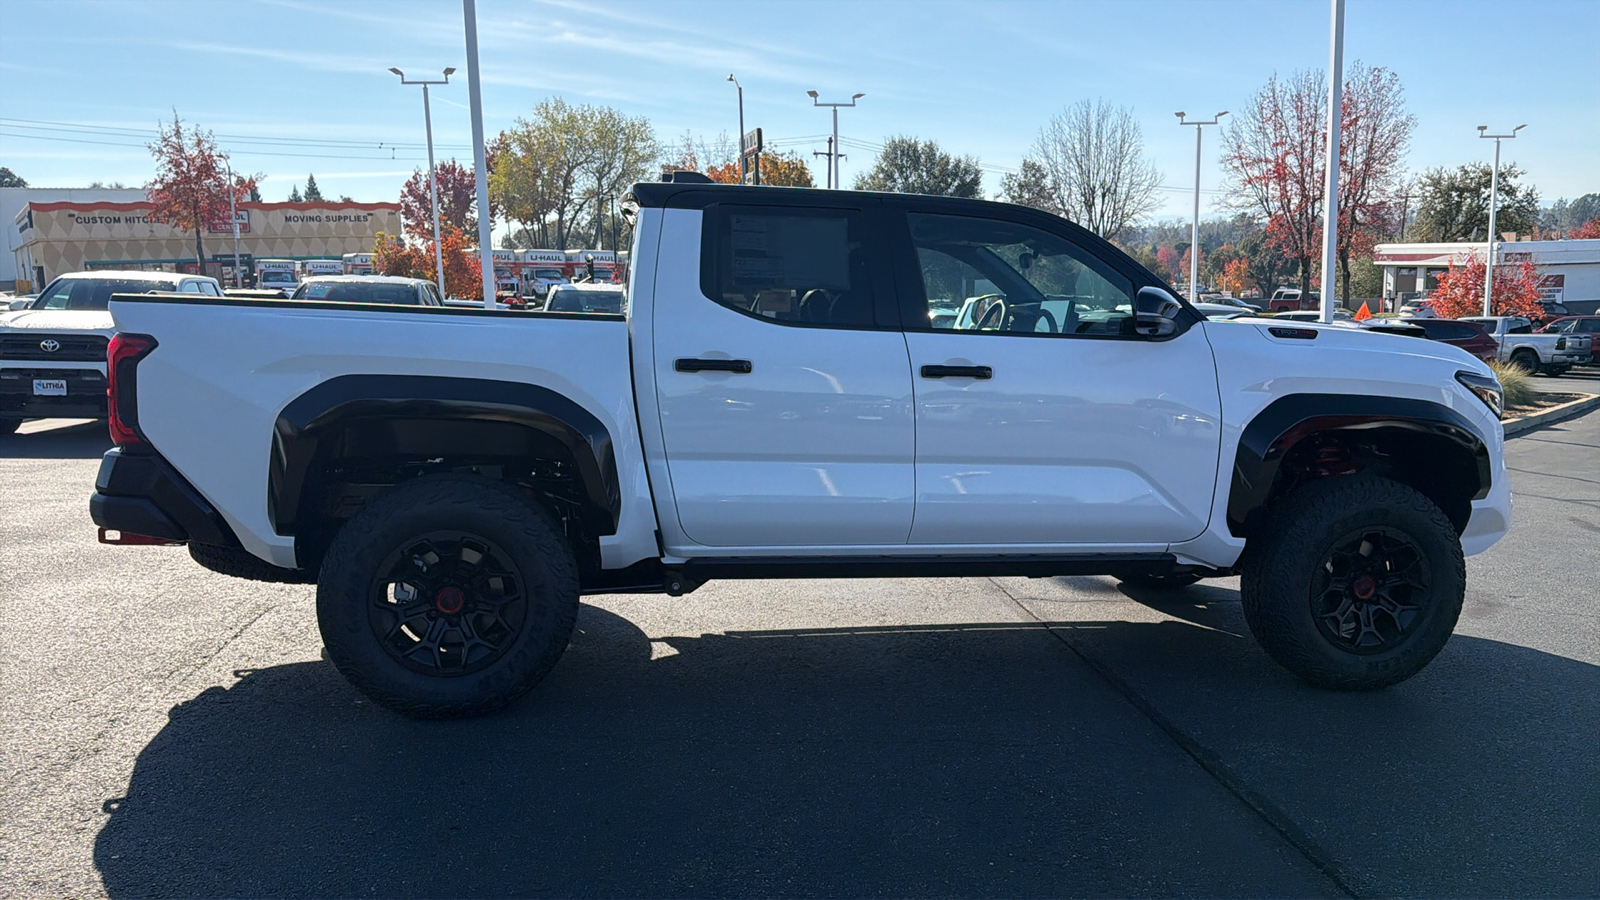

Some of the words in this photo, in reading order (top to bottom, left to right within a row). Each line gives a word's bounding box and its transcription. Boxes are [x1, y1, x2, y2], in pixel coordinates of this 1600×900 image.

[75, 216, 121, 224] CUSTOM
[284, 215, 322, 223] MOVING
[325, 215, 369, 223] SUPPLIES
[530, 254, 563, 262] U-HAUL
[42, 382, 65, 390] LITHIA
